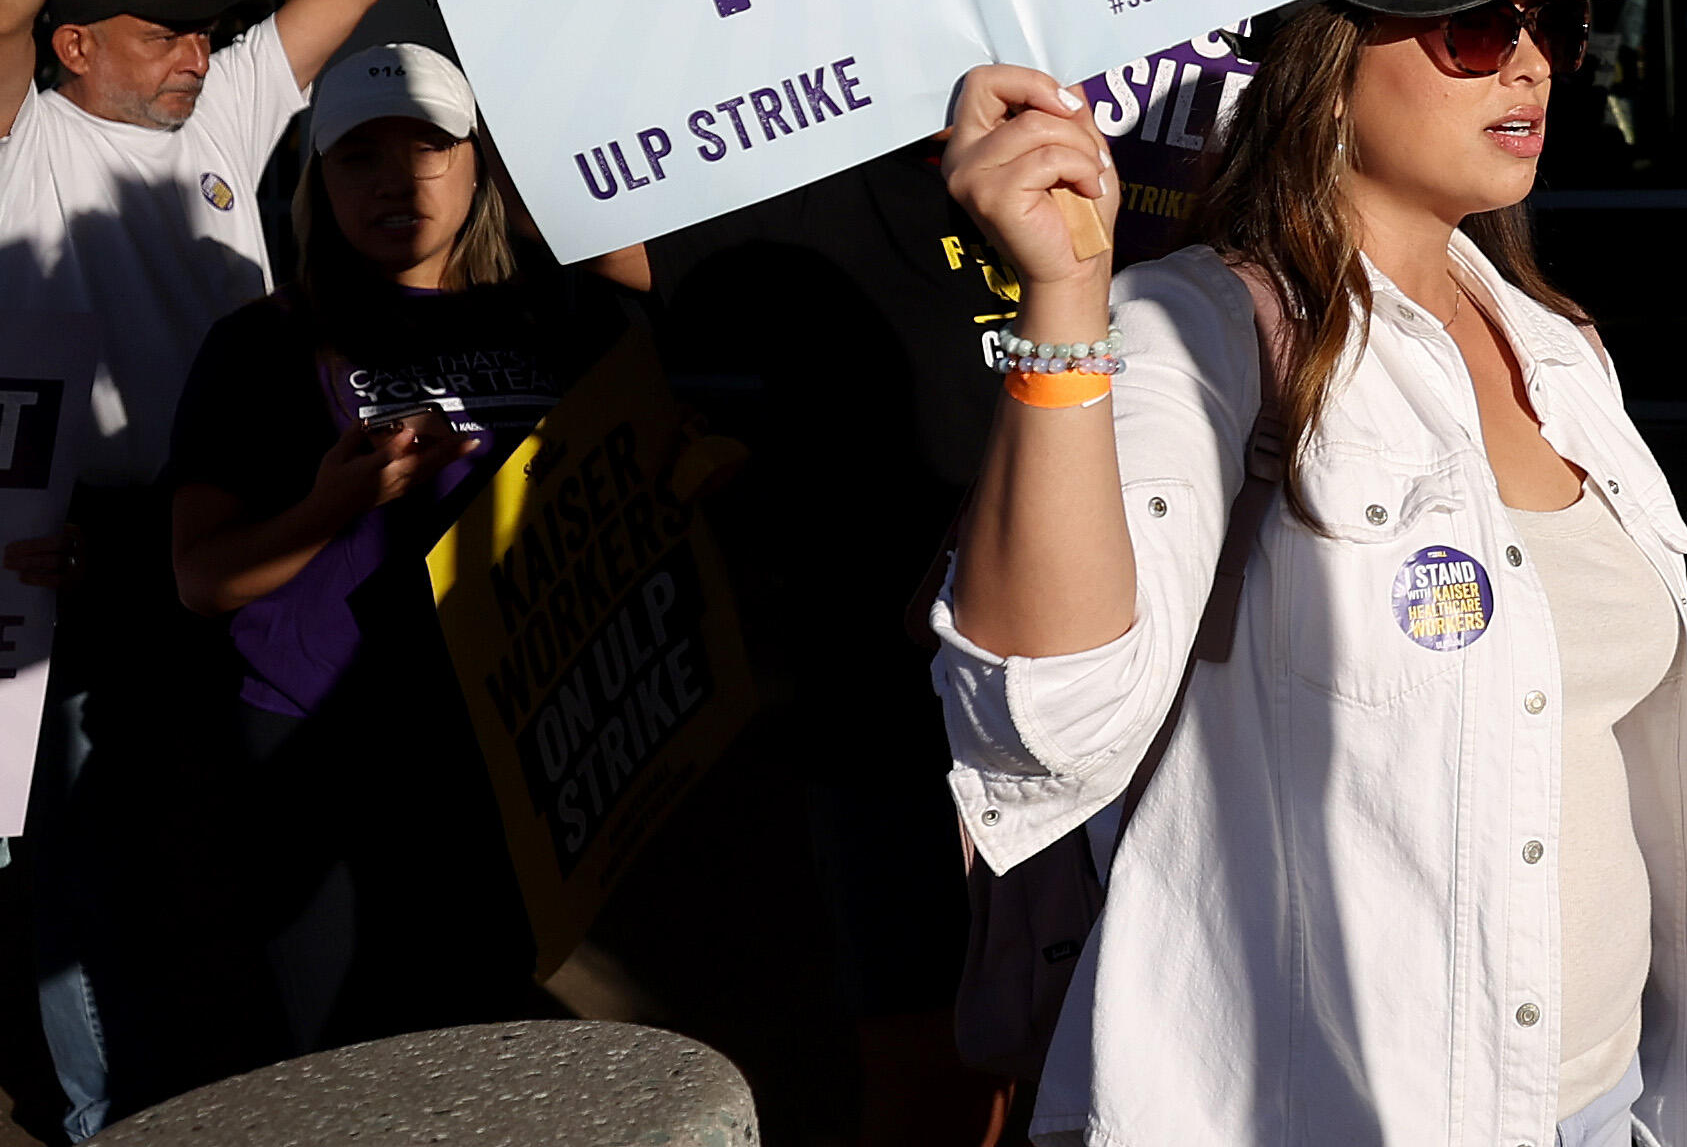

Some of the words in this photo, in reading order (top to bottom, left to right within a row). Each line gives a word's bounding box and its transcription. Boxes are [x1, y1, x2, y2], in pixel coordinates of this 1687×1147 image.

[575, 126, 672, 201] ULP
[692, 57, 873, 162] STRIKE
[490, 422, 641, 635] KAISER
[1415, 562, 1477, 588] STAND
[1432, 582, 1480, 602] KAISER
[535, 666, 595, 783] ON
[592, 571, 676, 701] ULP
[558, 637, 704, 853] STRIKE
